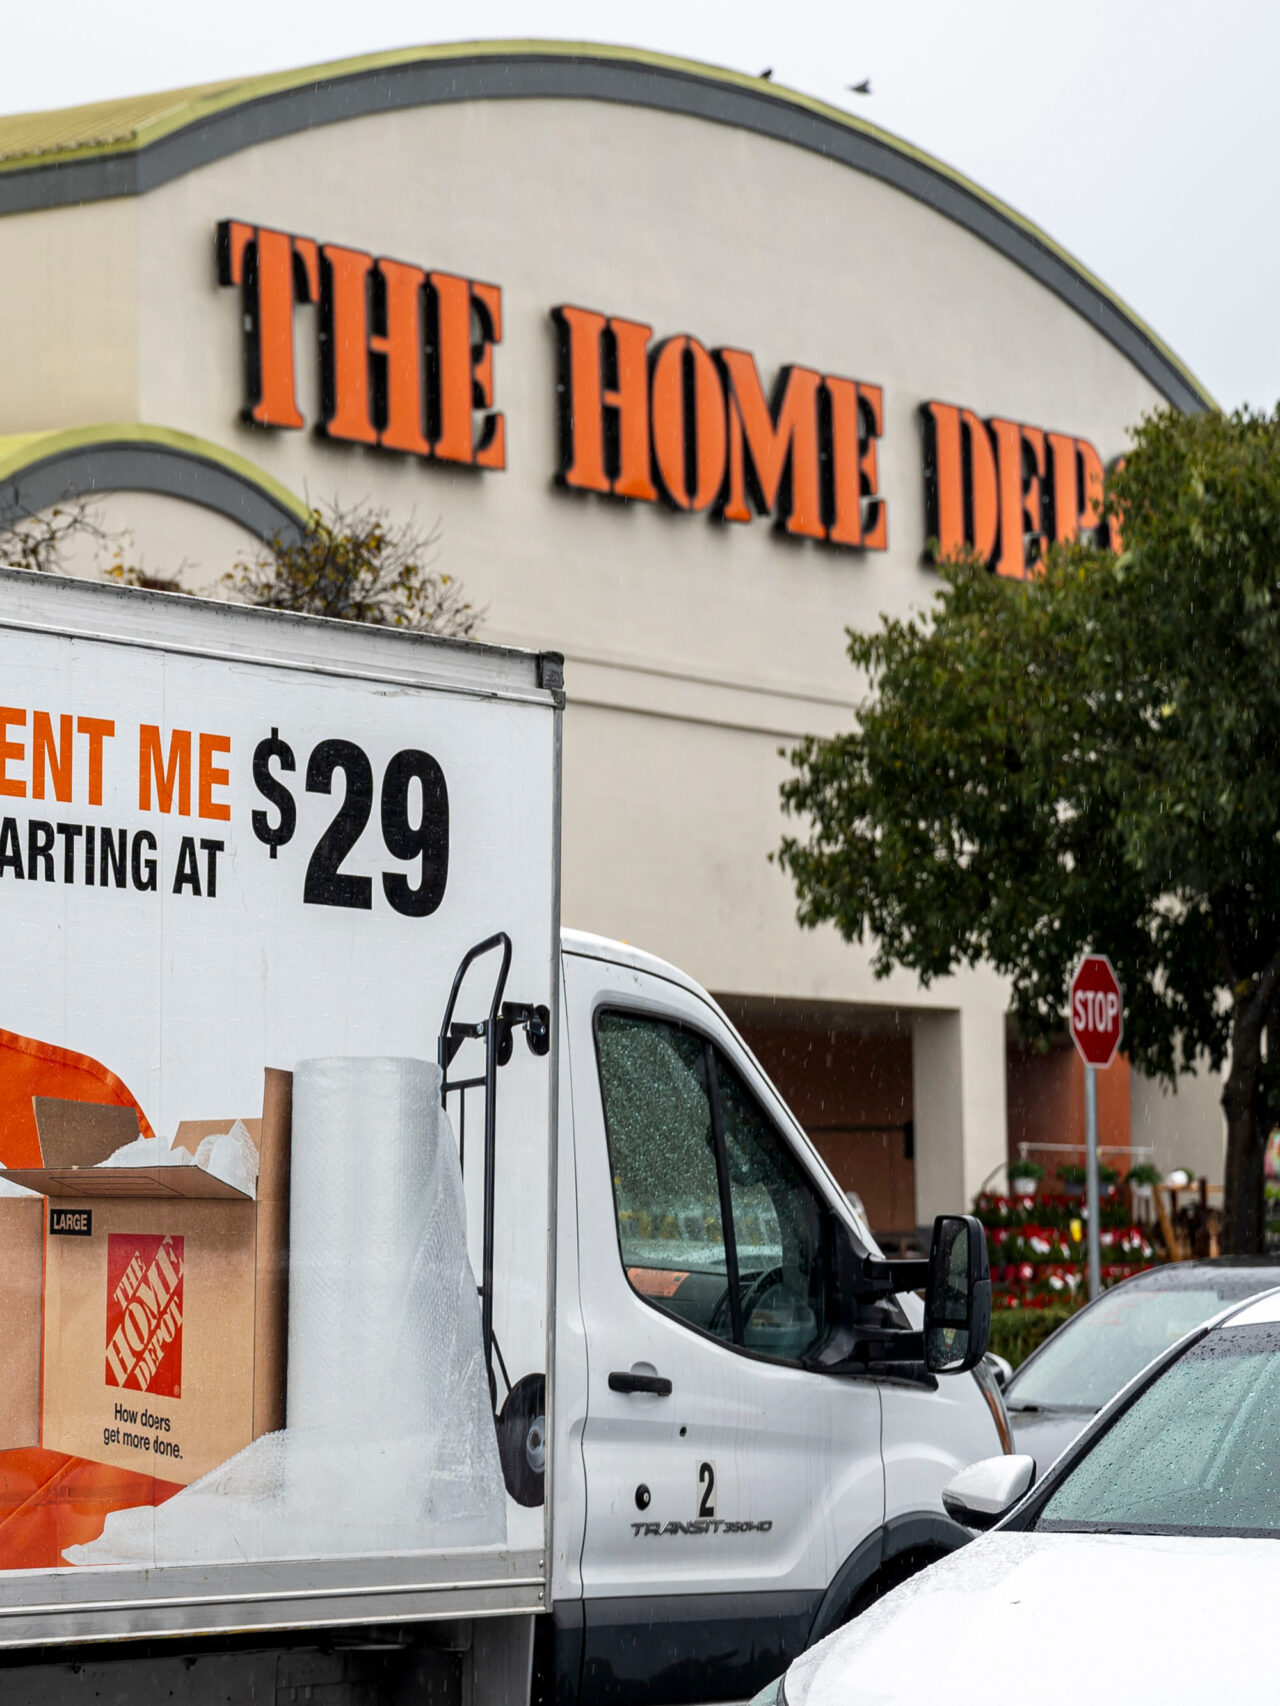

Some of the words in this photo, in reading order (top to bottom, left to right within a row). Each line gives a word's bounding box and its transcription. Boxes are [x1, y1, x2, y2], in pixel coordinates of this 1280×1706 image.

[217, 218, 507, 472] THE
[552, 303, 887, 552] HOME
[139, 722, 232, 822] ME
[251, 726, 450, 918] $29
[172, 835, 225, 898] AT
[1074, 989, 1119, 1033] STOP
[53, 1213, 88, 1231] LARGE
[105, 1234, 184, 1388] HOME
[113, 1250, 147, 1311] THE
[133, 1296, 184, 1392] DEPOT
[104, 1426, 121, 1447] get
[123, 1431, 151, 1450] more
[153, 1435, 184, 1460] done.
[114, 1402, 138, 1425] How
[140, 1407, 171, 1432] doers
[699, 1461, 715, 1518] 2
[631, 1519, 724, 1537] TRANSIT
[723, 1520, 773, 1534] 350HD
